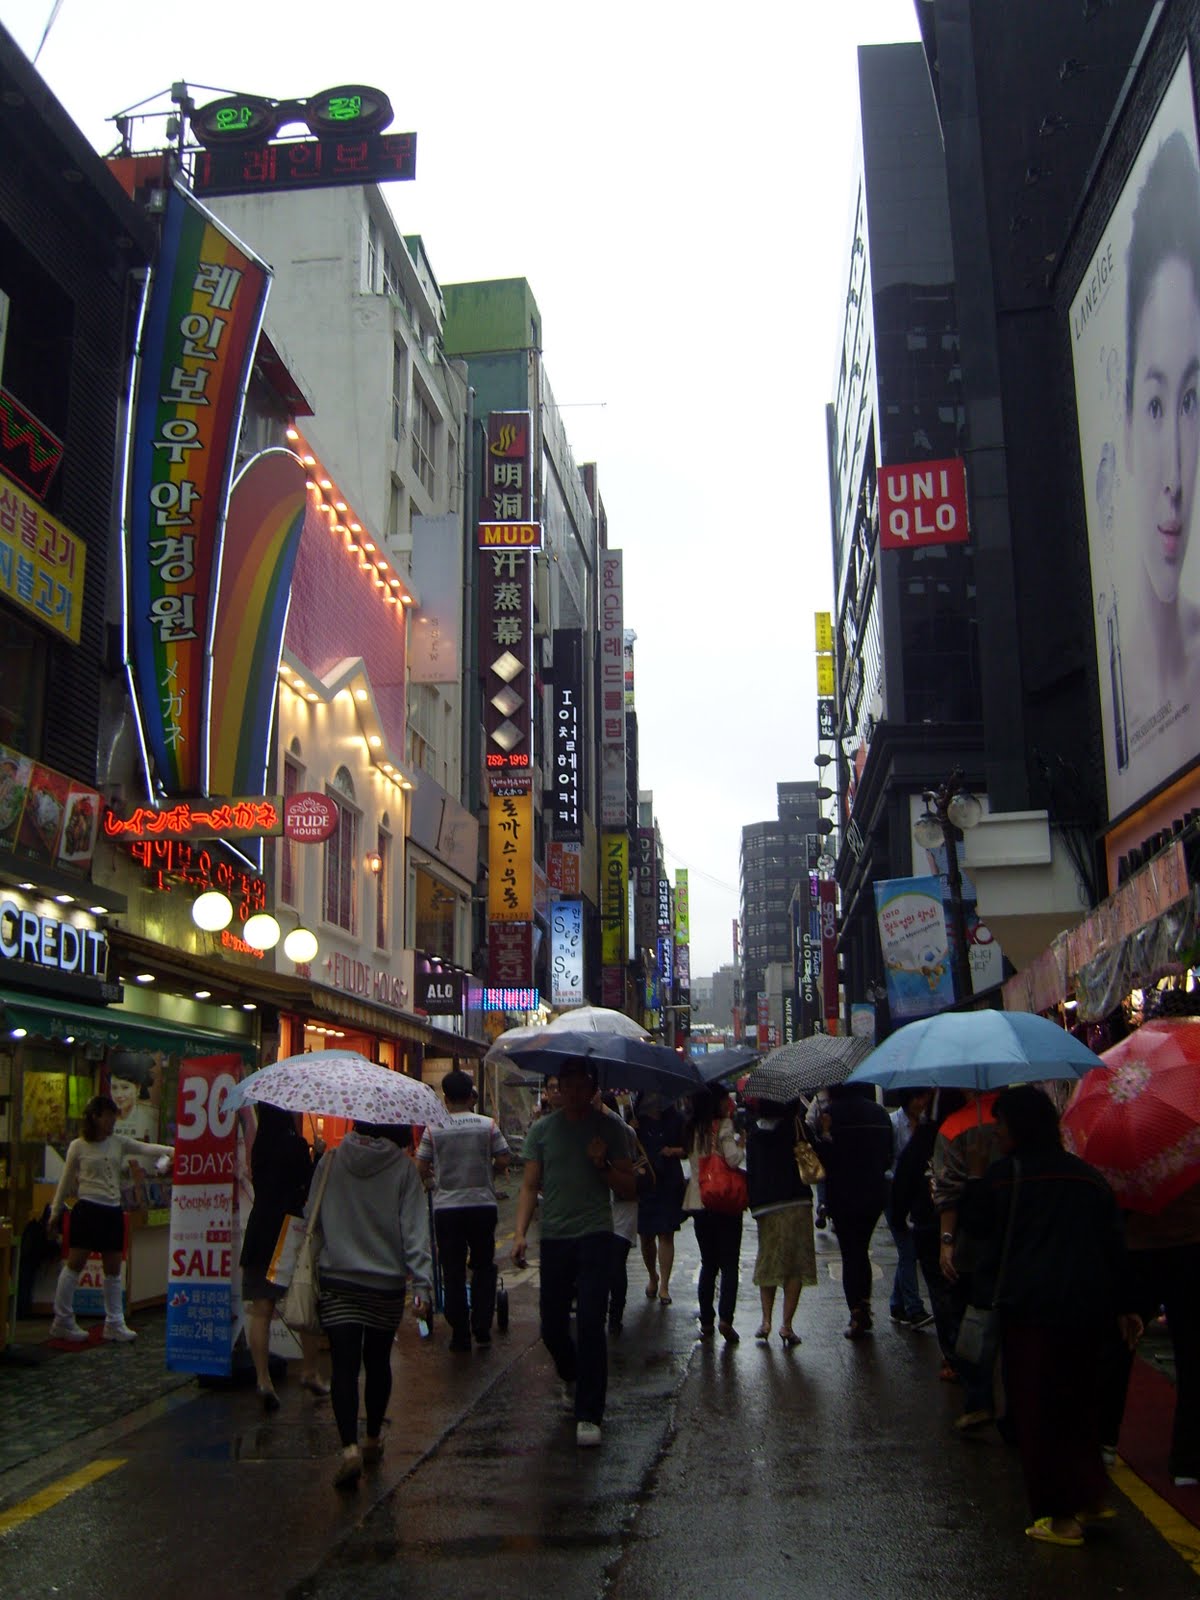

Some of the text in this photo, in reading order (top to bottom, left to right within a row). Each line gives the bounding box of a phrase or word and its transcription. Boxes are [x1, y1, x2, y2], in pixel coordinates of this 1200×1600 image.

[1075, 243, 1113, 340] LANEIGE
[493, 463, 524, 519] 明洞
[887, 470, 949, 502] UNI
[484, 526, 535, 544] MUD
[889, 503, 956, 540] QLO
[603, 559, 619, 631] Red Club
[162, 661, 185, 750] メガネ
[104, 801, 279, 837] レインボーメガネ
[287, 815, 329, 828] ETUDE
[293, 828, 322, 836] HOUSE
[0, 900, 105, 976] CREDIT
[334, 952, 371, 998] ETUDE
[427, 984, 453, 998] ALO
[785, 997, 793, 1026] NATURE
[178, 1073, 237, 1140] 30
[171, 1249, 231, 1277] SALE
